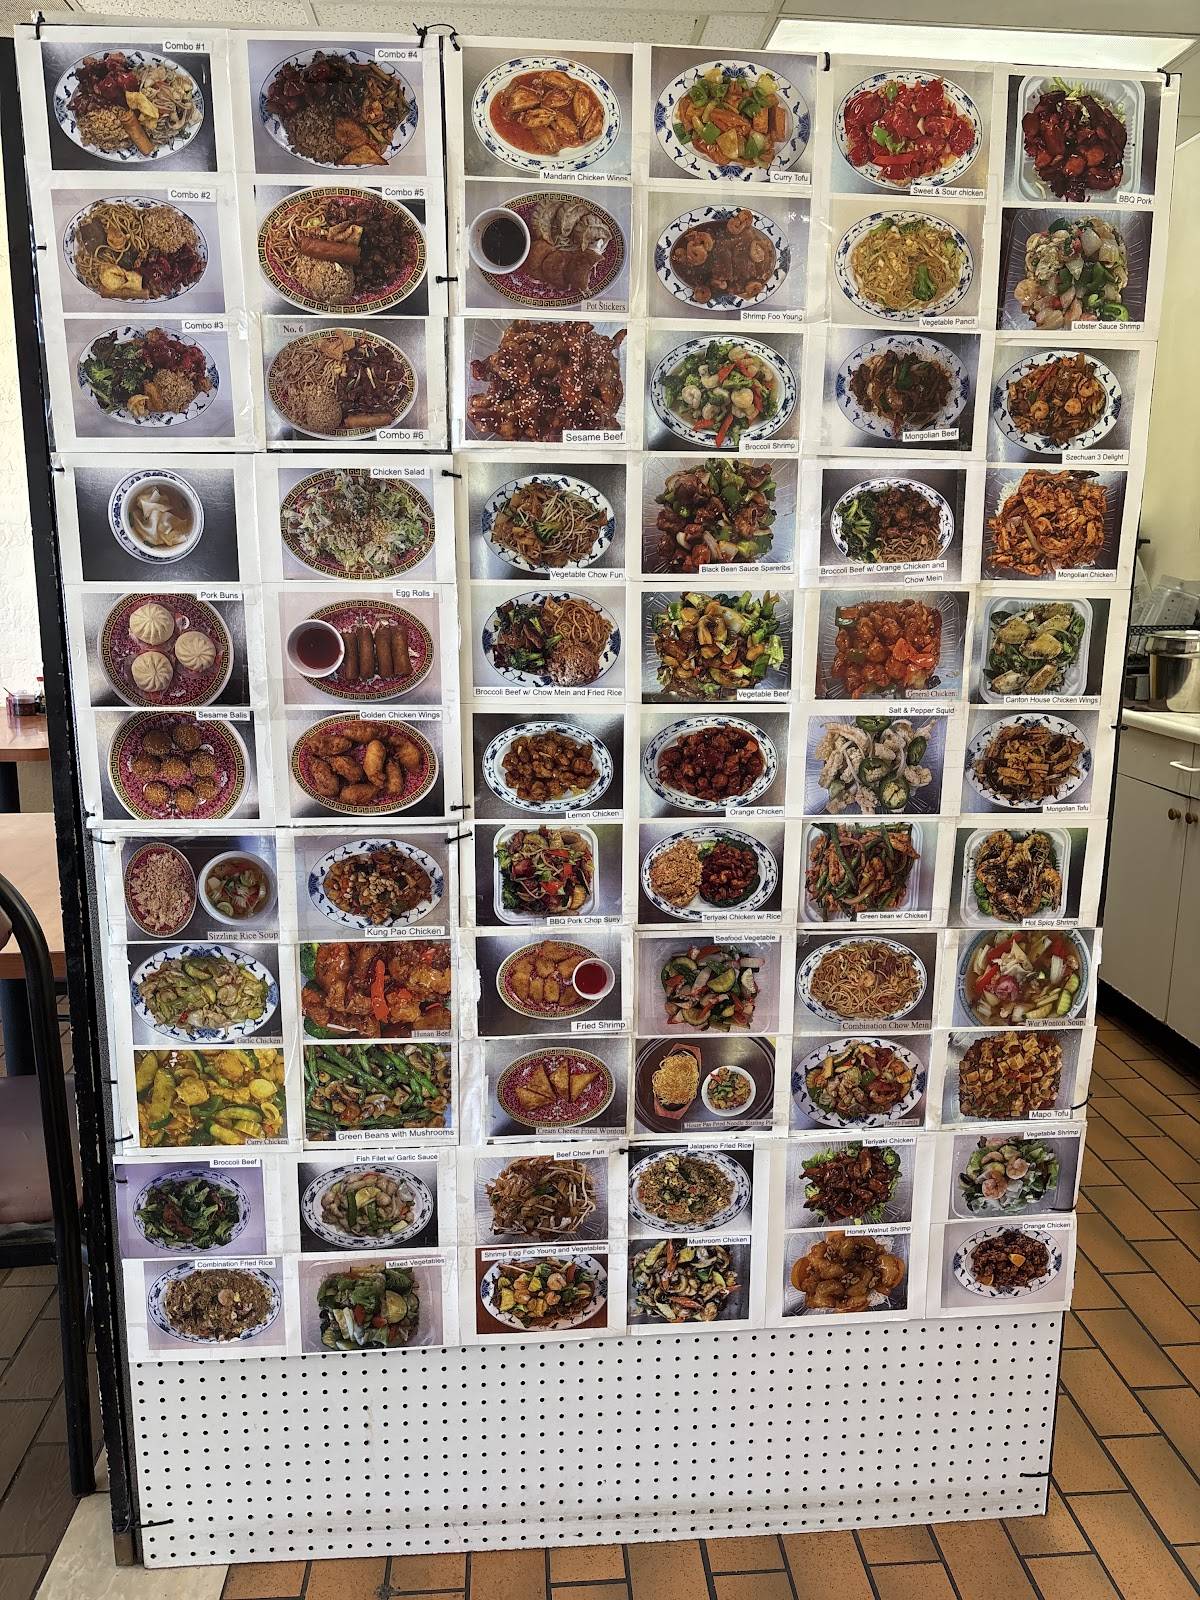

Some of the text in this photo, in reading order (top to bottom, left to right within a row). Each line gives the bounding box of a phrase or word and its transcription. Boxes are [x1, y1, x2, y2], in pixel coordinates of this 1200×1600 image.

[164, 41, 205, 51] Combo #1
[377, 49, 418, 59] Combo #4
[543, 171, 576, 181] Mandarin
[578, 173, 605, 182] Chicken
[774, 173, 809, 183] Curry Tofu
[170, 190, 211, 200] Combo #2
[384, 187, 425, 197] Combo #5
[913, 186, 933, 194] Sweet
[941, 188, 957, 196] Sour
[959, 189, 984, 197] chicken
[1119, 195, 1153, 206] BBQ Pork
[586, 301, 626, 311] Pot Stickers
[742, 312, 766, 321] Shrimp
[782, 312, 803, 322] Young
[184, 321, 224, 330] Combo #3
[921, 317, 976, 328] Vegetable Pancit
[1073, 322, 1142, 332] Lobster Sauce Shrimp
[283, 324, 304, 333] No. 6
[378, 430, 424, 440] Combo #6
[565, 432, 624, 442] Sesame Beef
[904, 429, 957, 441] Mongolian Beef
[745, 442, 796, 451] Broccoli Shrimp
[1065, 453, 1096, 461] Szechuan
[1103, 453, 1124, 462] Delight
[372, 468, 425, 476] Chicken Salad
[701, 566, 719, 574] Black
[739, 565, 759, 573] Sauce
[820, 566, 848, 575] Broccoli
[849, 565, 865, 574] Beef
[876, 564, 901, 573] Orange
[902, 562, 931, 570] Chicken
[551, 570, 624, 580] Vegetable Chow Fun
[904, 574, 942, 584] Chow Mein
[1058, 571, 1089, 579] Mongolian
[200, 592, 239, 600] Pork Buns
[412, 589, 431, 597] Rolls
[475, 688, 503, 696] Broccoli
[504, 688, 522, 696] Beef
[554, 688, 571, 696] Mein
[737, 690, 790, 699] Vegetable Beef
[1005, 696, 1099, 705] Canton House Chicken Wings
[198, 711, 248, 719] Sesame Balls
[360, 711, 440, 720] Golden Chicken Wings
[888, 706, 955, 716] Salt & Pepper Squid
[567, 809, 619, 819] Lemon Chicken
[729, 808, 784, 817] Orange Chicken
[584, 917, 602, 926] Chop
[603, 916, 621, 925] Suey
[702, 913, 728, 921] Teriyaki
[729, 913, 756, 921] Chicken
[766, 912, 781, 920] Rice
[208, 930, 279, 941] Sizzling Rice Soup
[366, 926, 442, 938] Kung Pao Chicken
[576, 1020, 626, 1031] Fried Shrimp
[842, 1021, 930, 1030] Combination Chow Mein
[1031, 1109, 1069, 1119] Mapo Tofu
[338, 1128, 455, 1140] Green Beans with Mushrooms
[737, 1141, 752, 1149] Rice
[864, 1136, 914, 1146] Teriyaki Chicken
[355, 1154, 371, 1162] Fish
[395, 1153, 416, 1161] Garlic
[555, 1150, 571, 1158] Beef
[688, 1237, 721, 1245] Mushroom
[484, 1250, 507, 1259] Shrimp
[536, 1246, 556, 1256] Young
[557, 1246, 571, 1254] and
[571, 1243, 607, 1253] Vegetables
[197, 1260, 239, 1268] Combination
[240, 1259, 257, 1267] Fried
[387, 1256, 445, 1267] Mixed Vegetables
